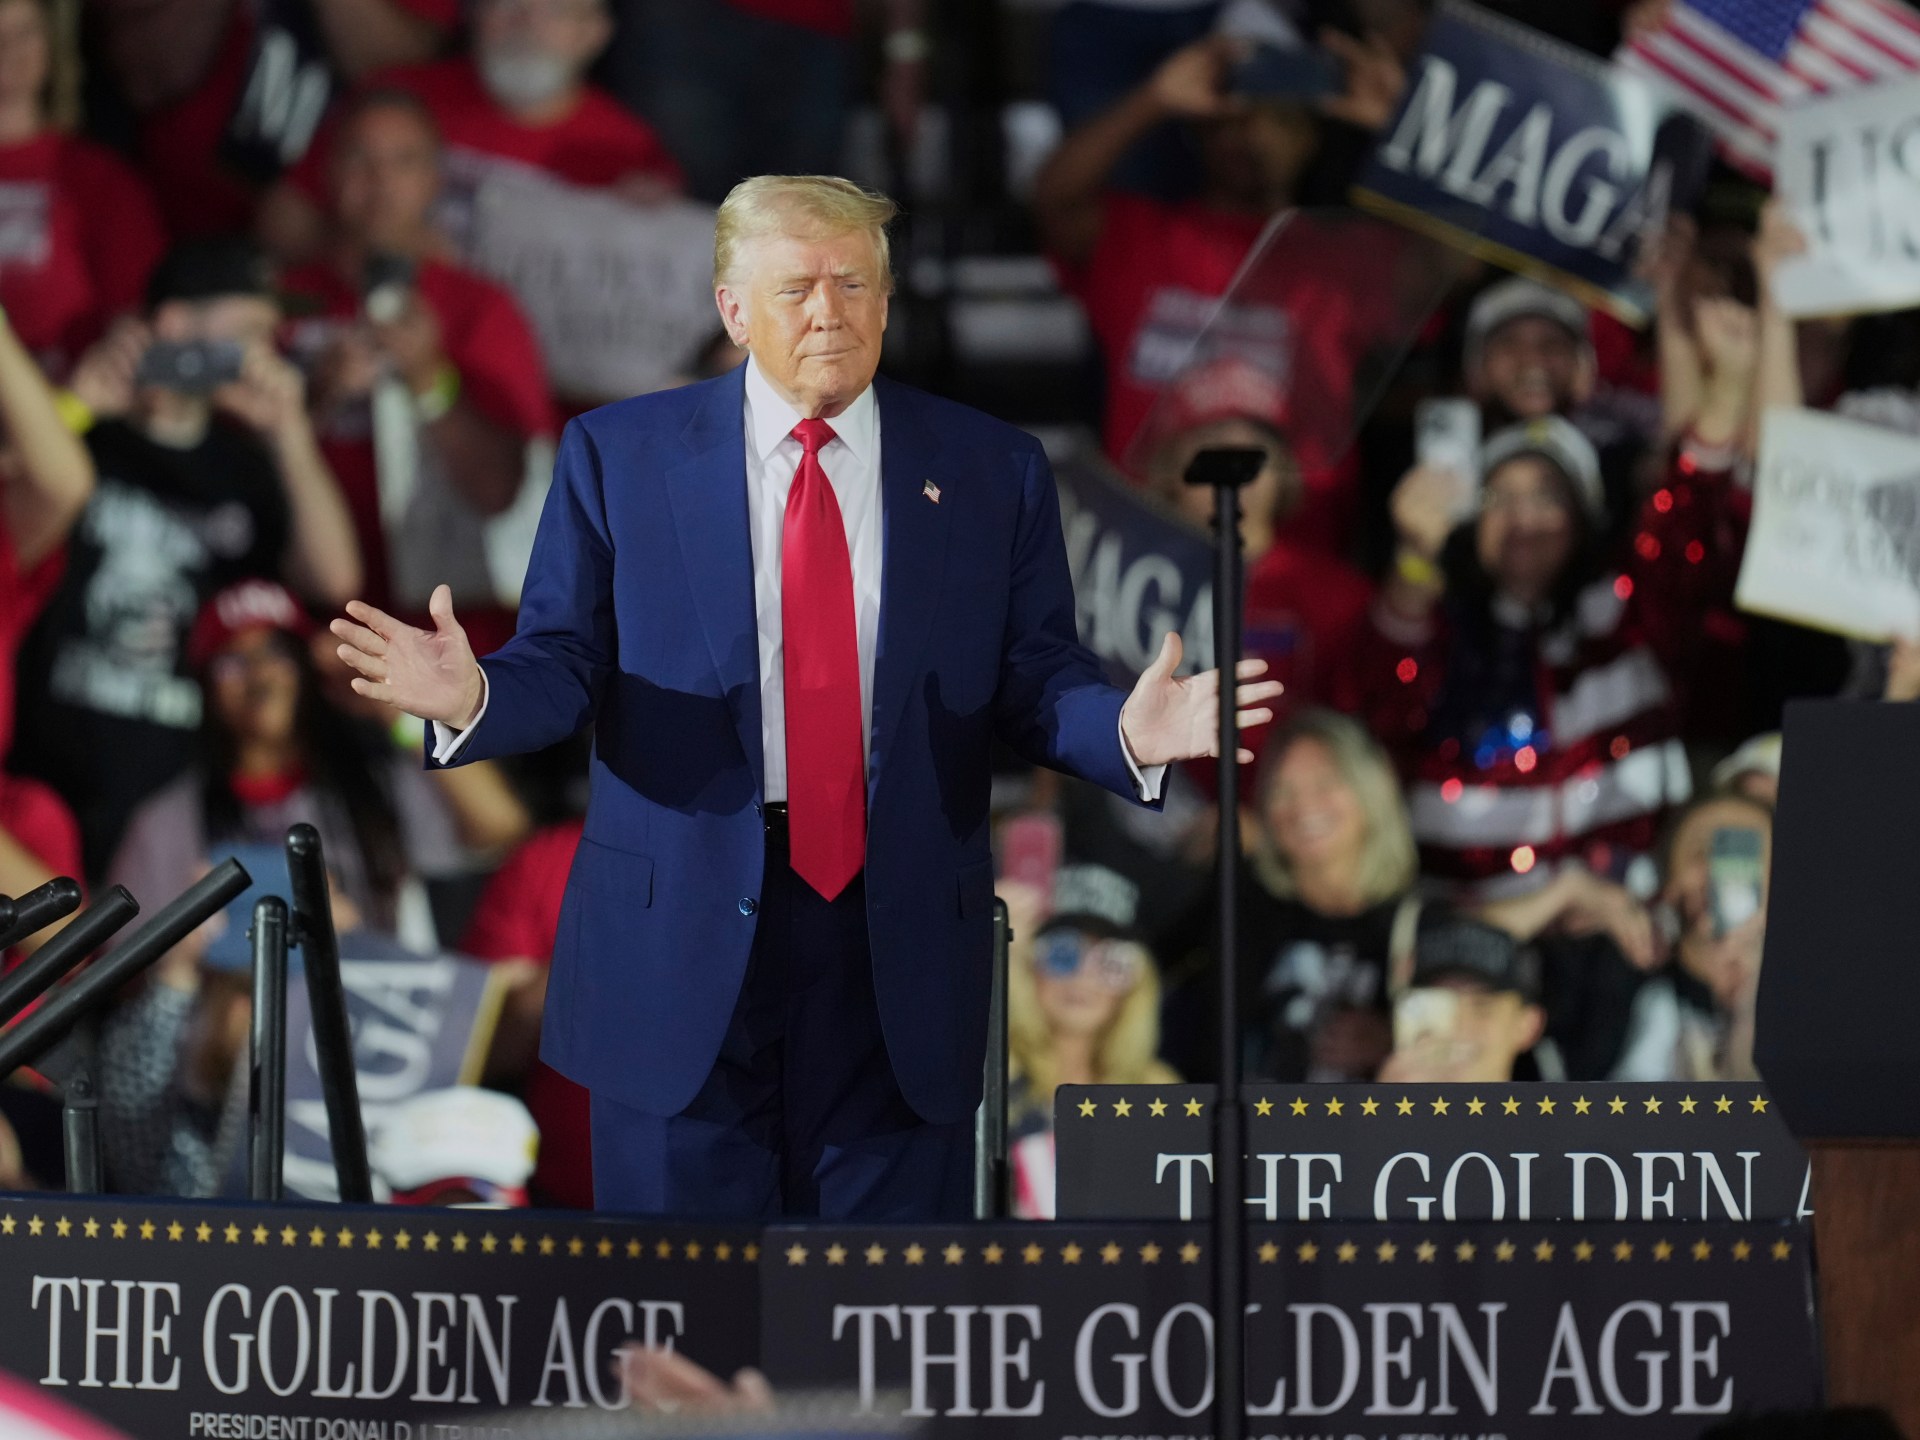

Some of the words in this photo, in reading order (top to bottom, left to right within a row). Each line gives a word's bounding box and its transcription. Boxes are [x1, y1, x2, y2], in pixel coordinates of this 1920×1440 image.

[32, 1275, 181, 1390] THE
[203, 1283, 517, 1405] GOLDEN
[832, 1303, 1045, 1418] THE
[1530, 1301, 1734, 1417] AGE
[190, 1412, 310, 1440] PRESIDENT
